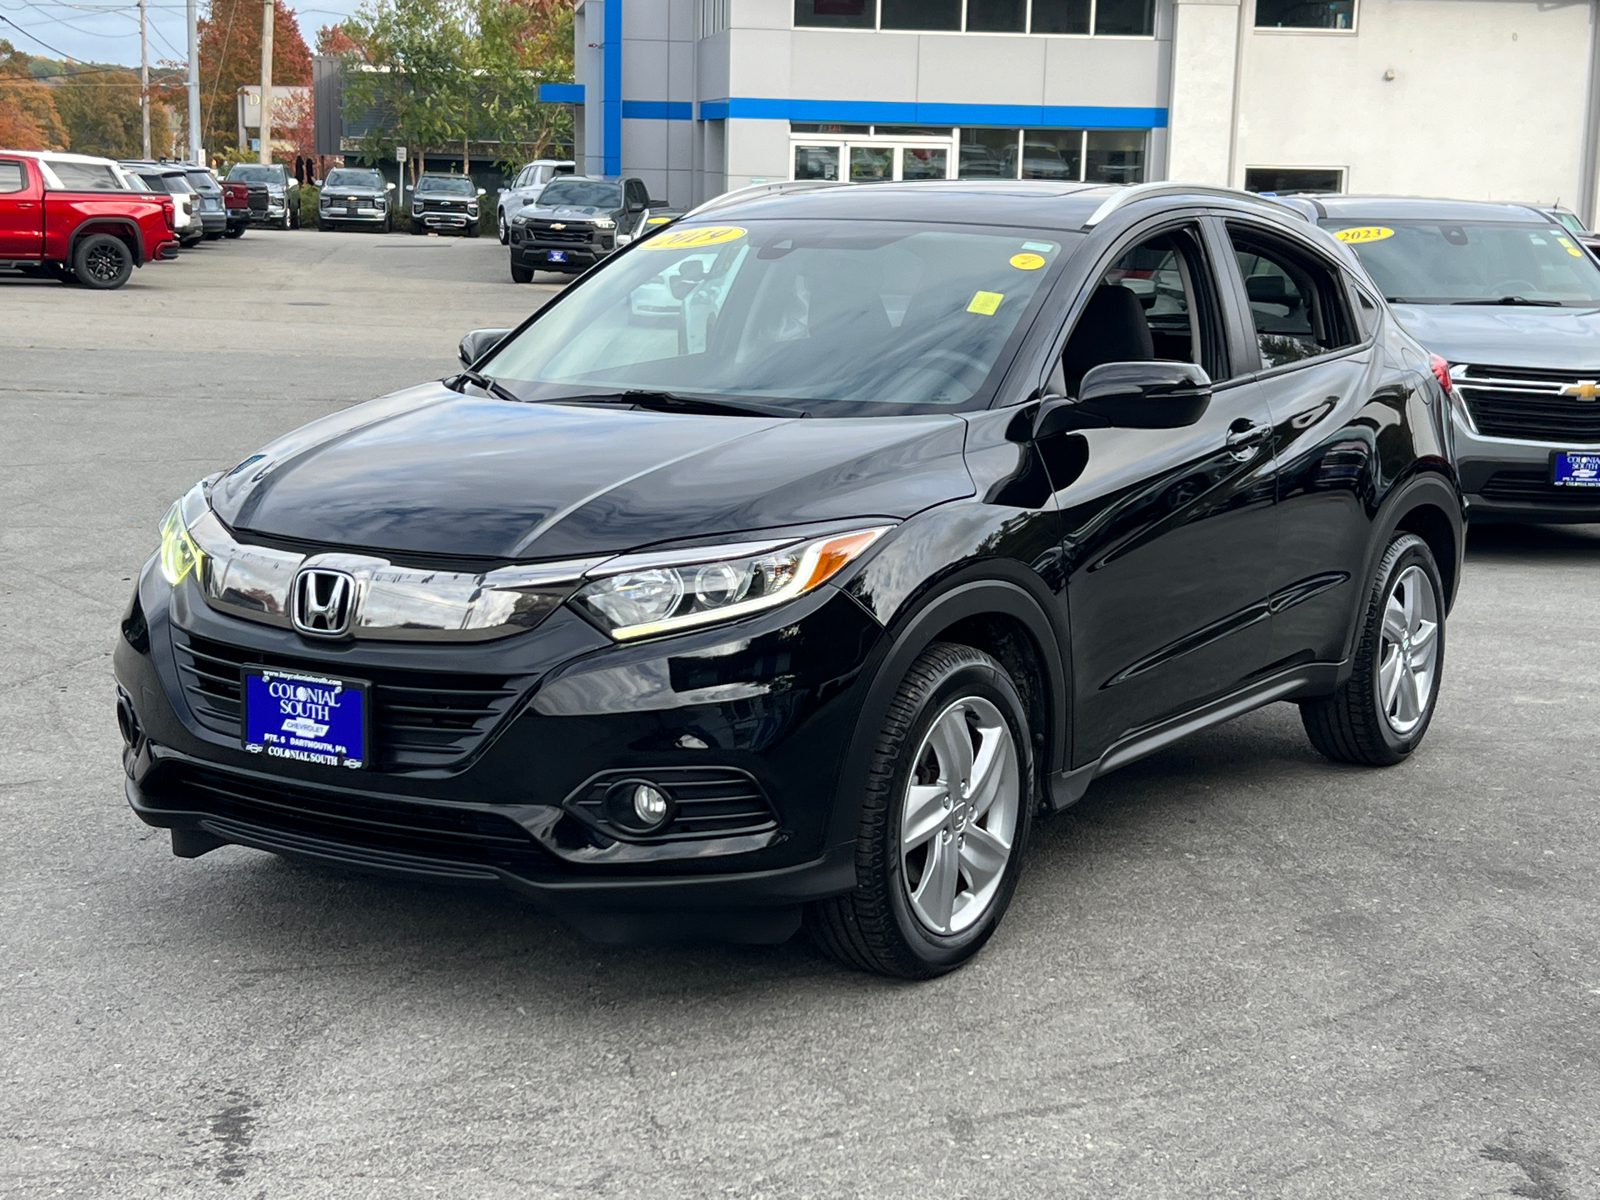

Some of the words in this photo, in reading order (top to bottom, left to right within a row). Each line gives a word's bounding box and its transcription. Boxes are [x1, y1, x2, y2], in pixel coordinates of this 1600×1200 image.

[1342, 228, 1381, 241] 2023
[1567, 456, 1600, 464] COLONIA
[269, 682, 341, 707] COLONIAL
[280, 699, 329, 720] SOUTH
[286, 721, 324, 733] CHEVROLET
[268, 746, 309, 762] COLONIAL
[310, 753, 338, 766] SOUTH
